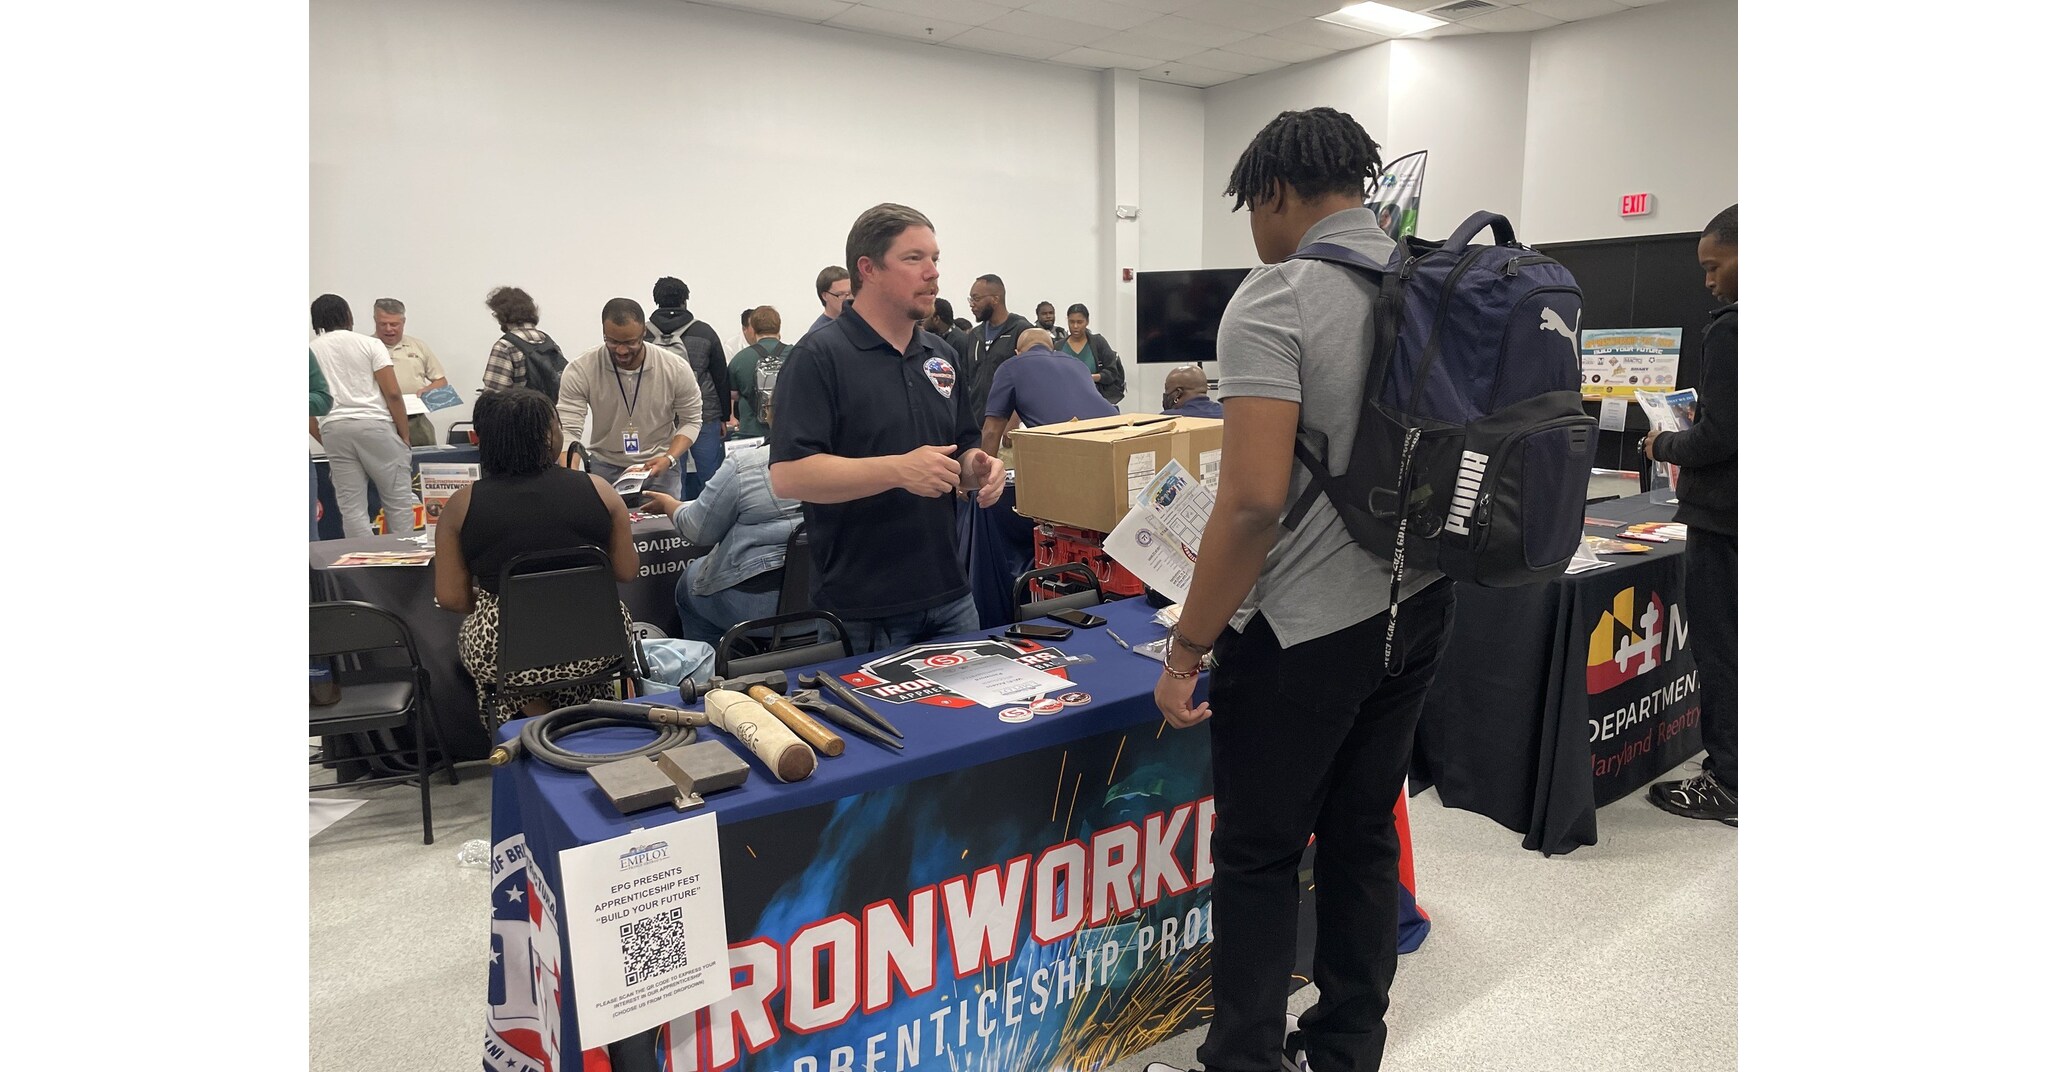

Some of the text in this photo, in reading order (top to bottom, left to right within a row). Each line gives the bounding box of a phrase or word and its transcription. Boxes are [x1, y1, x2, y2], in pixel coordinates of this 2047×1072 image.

[1622, 193, 1647, 214] EXIT
[1444, 450, 1489, 536] PUMA
[633, 537, 694, 554] eative
[1589, 669, 1701, 742] DEPARTMEN
[1656, 706, 1701, 746] Reentry
[620, 847, 668, 869] EMPLOY
[594, 874, 700, 913] APPRENTICESHIP FEST
[611, 866, 683, 894] EPG PRESENTS
[632, 900, 659, 914] YOUR
[596, 997, 618, 1008] PLEASE
[619, 992, 634, 1001] SCAN
[635, 987, 646, 995] THE
[655, 980, 670, 988] CODE
[678, 967, 702, 979] EXPRESS
[702, 961, 716, 970] YOUR
[613, 996, 640, 1009] INTEREST
[647, 989, 659, 997] OUR
[659, 972, 703, 992] APPRENTICESHIP
[639, 1001, 646, 1009] US
[647, 996, 662, 1005] FROM
